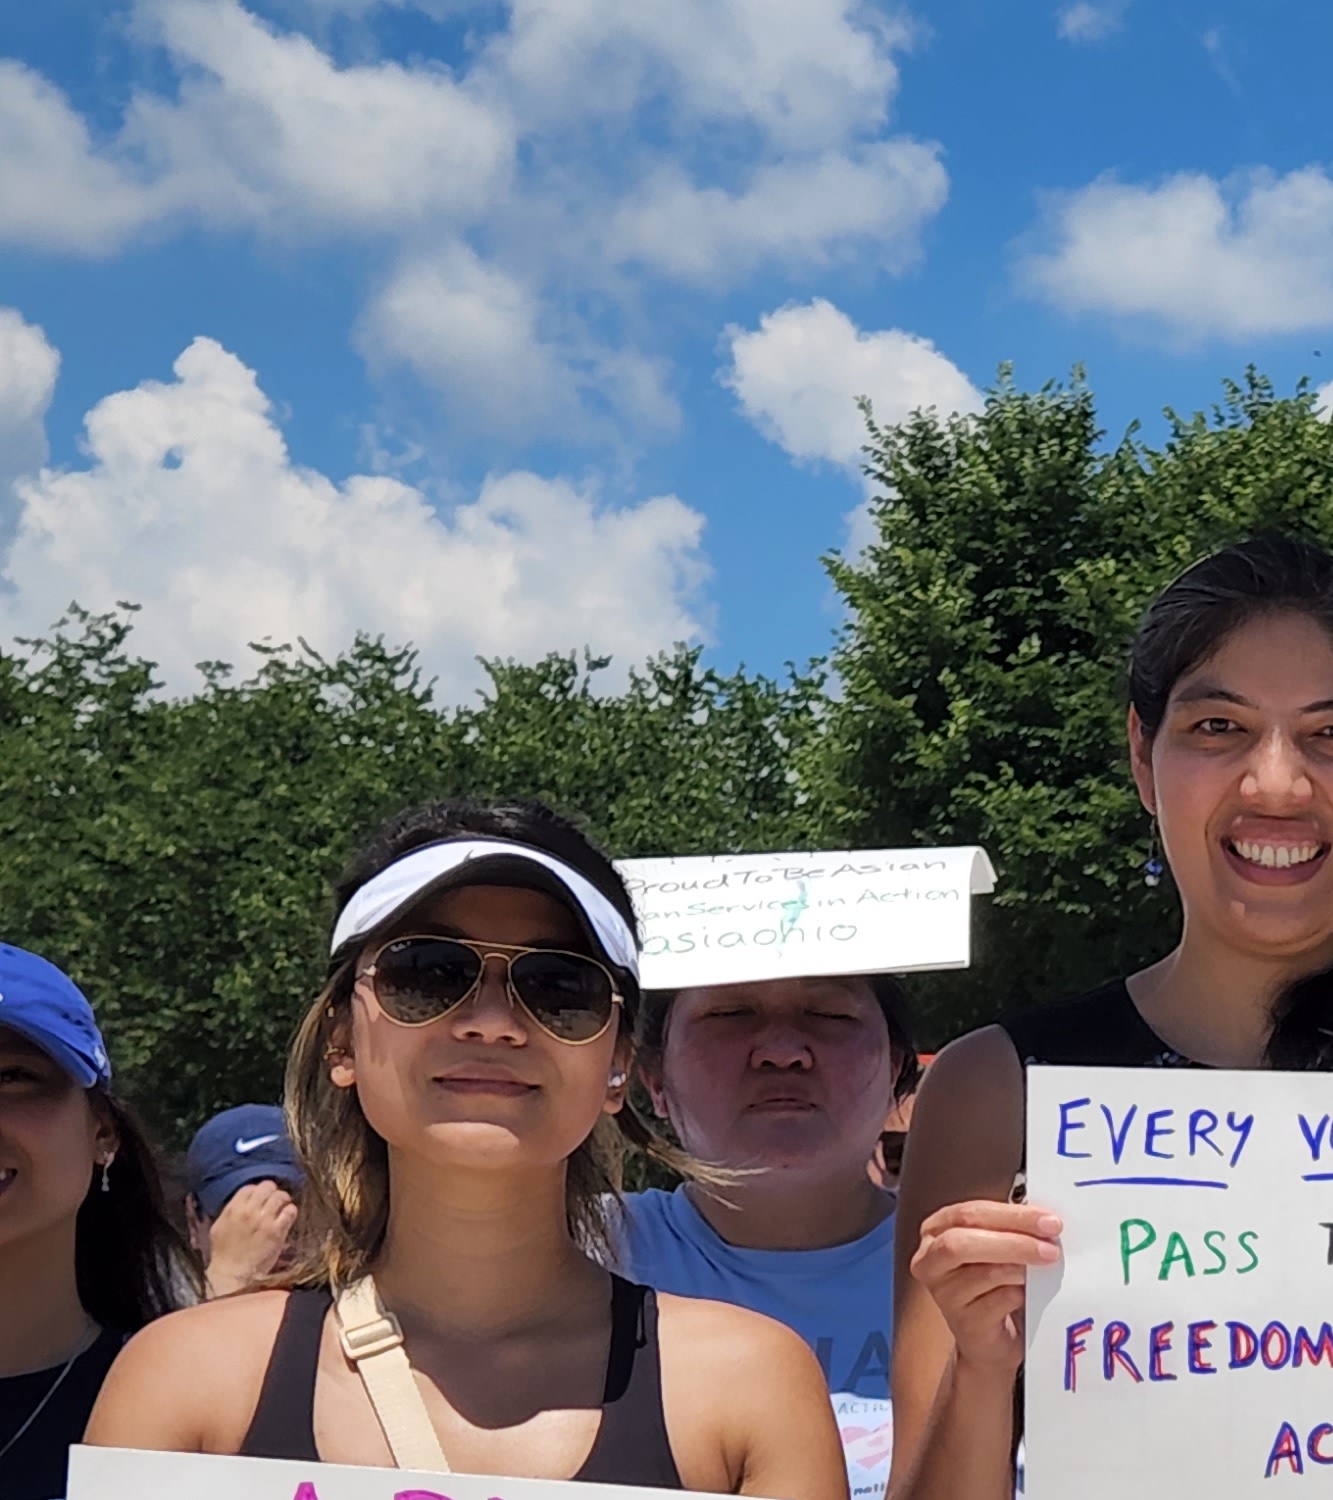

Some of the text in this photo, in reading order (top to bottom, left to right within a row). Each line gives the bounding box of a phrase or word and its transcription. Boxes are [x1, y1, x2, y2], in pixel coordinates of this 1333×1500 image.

[733, 870, 773, 885] To
[831, 861, 946, 878] Asian
[818, 897, 846, 907] in
[856, 887, 960, 904] Action
[1057, 1097, 1254, 1166] EVERY
[1120, 1218, 1260, 1284] PASS
